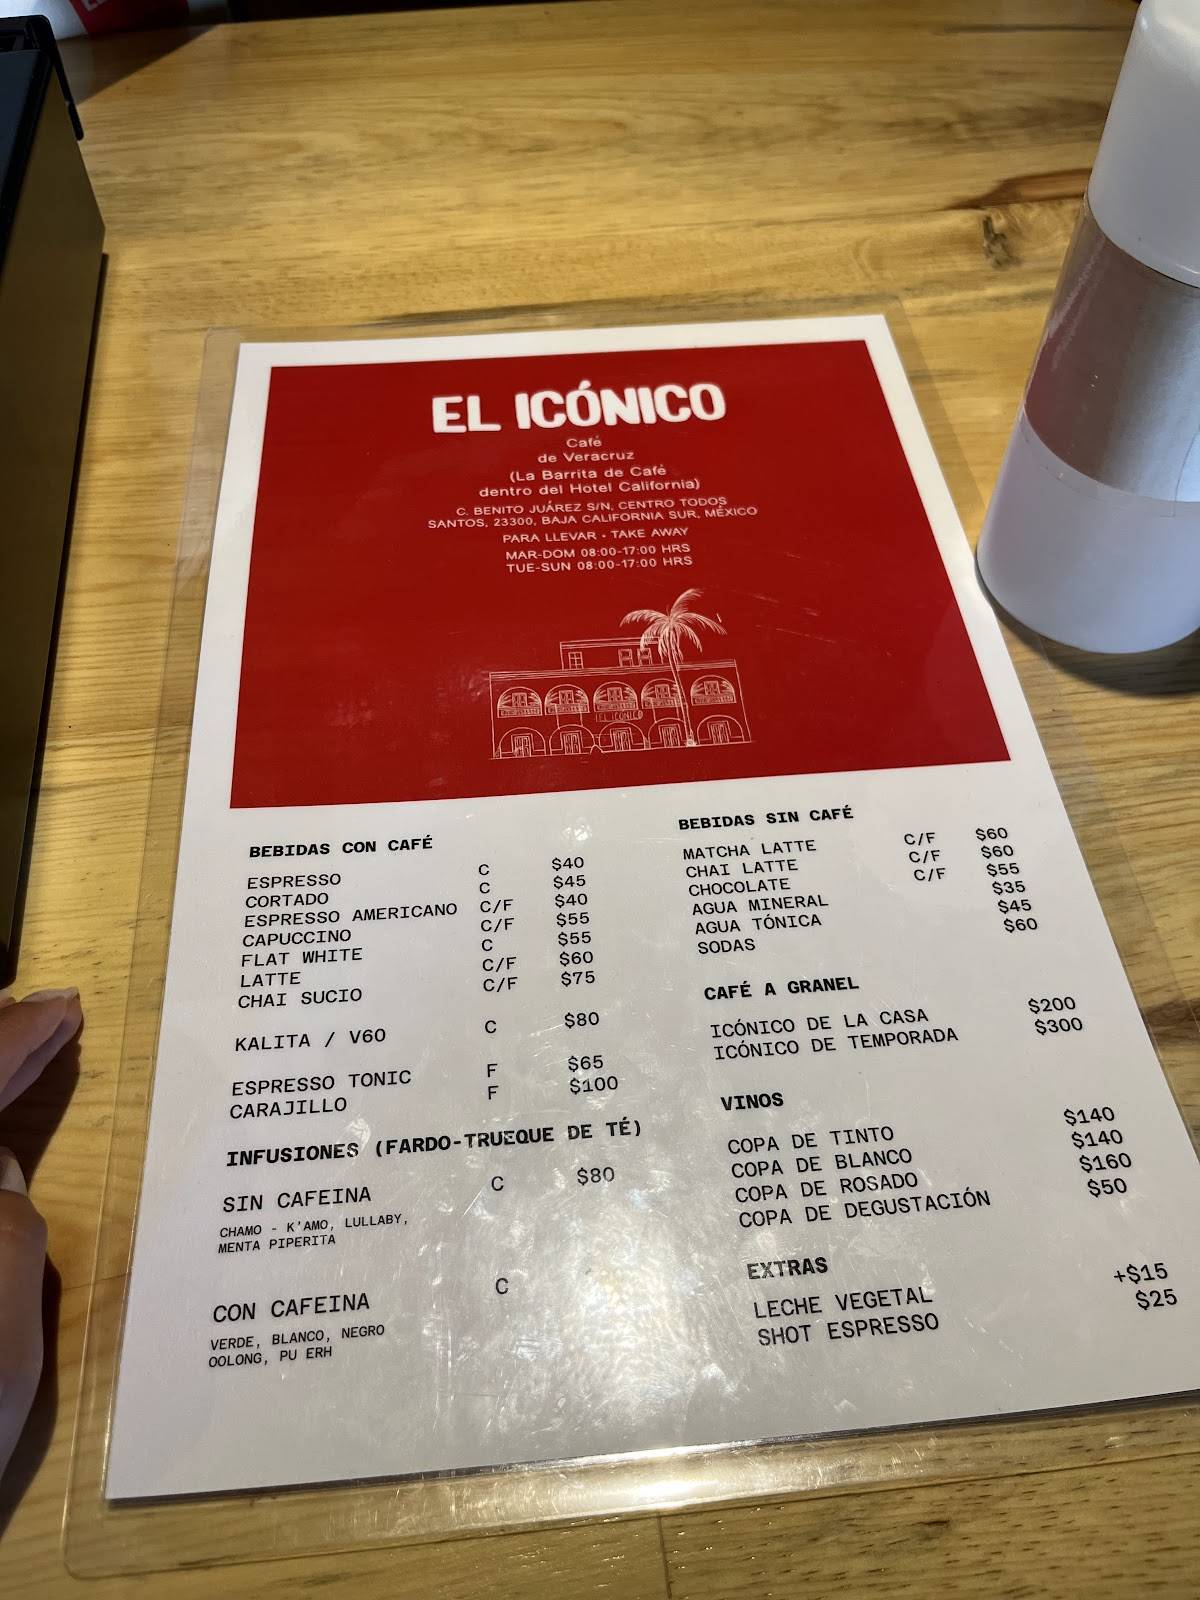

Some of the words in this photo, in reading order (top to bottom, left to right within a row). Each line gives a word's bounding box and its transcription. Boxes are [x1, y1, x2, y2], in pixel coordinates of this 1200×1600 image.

[432, 395, 502, 433] EL
[515, 379, 726, 429] ICÓNICO
[538, 454, 557, 463] de
[563, 452, 634, 462] Veracruz
[566, 436, 602, 447] Café
[479, 487, 532, 497] dentro
[539, 485, 563, 495] del
[570, 483, 612, 493] Hotel
[619, 478, 700, 492] California)
[510, 471, 535, 483] (La
[542, 470, 597, 480] Barrita
[604, 468, 623, 477] de
[630, 464, 666, 476] Café
[456, 508, 468, 516] C.
[474, 505, 524, 515] BENITO
[529, 501, 581, 513] JUÁREZ
[618, 499, 675, 509] CENTRO
[680, 496, 727, 507] TODOS
[542, 516, 577, 525] BAJA
[582, 512, 664, 523] CALIFORNIA
[704, 506, 758, 517] MÉXICO
[503, 534, 540, 543] PARA
[545, 532, 597, 541] LLEVAR
[611, 529, 645, 538] TAKE
[651, 528, 688, 537] AWAY
[506, 549, 575, 560] MAR-DOM
[581, 546, 656, 557] 08:00-17:00
[662, 544, 690, 553] HRS
[506, 562, 571, 573] TUE-SUN
[577, 558, 657, 570] 08:00-17:00
[663, 556, 692, 566] HRS
[679, 814, 755, 830] BEBIDAS
[766, 811, 799, 824] SIN
[810, 805, 854, 821] CAFÉ
[249, 843, 330, 858] BEBIDAS
[342, 841, 376, 853] CON
[388, 835, 432, 851] CAFÉ
[683, 845, 750, 860] MATCHA
[761, 840, 816, 854] LATTE
[904, 832, 935, 846] C/F
[976, 828, 1008, 842] $60
[248, 874, 341, 889] ESPRESSO
[479, 864, 489, 875] C
[552, 857, 584, 871] $40
[686, 864, 730, 878] CHAI
[742, 859, 798, 874] LATTE
[909, 850, 940, 863] C/F
[981, 845, 1013, 859] $60
[246, 893, 328, 908] CORTADO
[479, 882, 490, 894] C
[554, 875, 586, 890] $45
[689, 878, 791, 896] CHOCOLATE
[914, 868, 945, 882] C/F
[986, 863, 1019, 877] $55
[245, 911, 340, 927] ESPRESSO
[352, 903, 457, 921] AMERICANO
[480, 899, 513, 913] C/F
[555, 893, 587, 908] $40
[693, 901, 737, 915] AGUA
[748, 895, 829, 911] MINERAL
[992, 881, 1025, 895] $35
[243, 929, 351, 947] CAPUCCINO
[481, 918, 514, 932] C/F
[557, 912, 589, 927] $55
[696, 920, 741, 935] AGUA
[752, 914, 822, 930] TÓNICA
[998, 899, 1031, 914] $45
[242, 952, 290, 967] FLAT
[303, 948, 362, 963] WHITE
[482, 939, 493, 951] C
[558, 931, 591, 947] $55
[698, 938, 755, 954] SODAS
[1004, 918, 1038, 933] $60
[241, 972, 301, 987] LATTE
[483, 957, 516, 972] C/F
[560, 951, 593, 967] $60
[238, 993, 287, 1008] CHAI
[301, 988, 362, 1004] SUCIO
[483, 977, 518, 992] C/F
[561, 971, 595, 987] $75
[704, 981, 752, 1000] CAFÉ
[765, 983, 776, 996] A
[787, 977, 859, 994] GRANEL
[235, 1034, 310, 1051] KALITA
[325, 1032, 335, 1047] /
[349, 1029, 386, 1044] V60
[485, 1020, 496, 1033] C
[565, 1012, 599, 1029] $80
[710, 1019, 795, 1038] ICÓNICO
[807, 1016, 832, 1030] DE
[844, 1013, 868, 1028] LA
[880, 1009, 929, 1025] CASA
[1028, 997, 1075, 1014] $200
[714, 1040, 799, 1060] ICÓNICO
[811, 1037, 836, 1052] DE
[847, 1028, 958, 1049] TEMPORADA
[1035, 1018, 1083, 1036] $300
[232, 1076, 334, 1096] ESPRESSO
[348, 1070, 411, 1088] TONIC
[487, 1063, 498, 1077] F
[568, 1055, 603, 1072] $65
[230, 1097, 347, 1119] CARAJILLO
[488, 1085, 499, 1100] F
[570, 1076, 618, 1095] $100
[720, 1092, 784, 1110] VINOS
[227, 1143, 358, 1166] INFUSIONES
[376, 1127, 554, 1157] (FARDO-TRUEQUE
[568, 1124, 592, 1140] DE
[606, 1117, 640, 1136] TÉ)
[728, 1136, 780, 1154] COPA
[792, 1133, 818, 1149] DE
[829, 1126, 894, 1145] TINTO
[1064, 1107, 1114, 1126] $140
[732, 1160, 783, 1178] COPA
[796, 1156, 822, 1173] DE
[835, 1148, 912, 1169] BLANCO
[1071, 1130, 1123, 1149] $140
[223, 1195, 263, 1212] SIN
[278, 1187, 371, 1208] CAFEINA
[491, 1176, 504, 1191] C
[577, 1167, 614, 1186] $80
[735, 1184, 788, 1203] COPA
[801, 1180, 827, 1197] DE
[840, 1172, 918, 1194] ROSADO
[1079, 1153, 1131, 1173] $160
[739, 1209, 792, 1228] COPA
[805, 1205, 832, 1222] DE
[844, 1187, 990, 1218] DEGUSTACIÓN
[1087, 1178, 1127, 1198] $50
[220, 1225, 261, 1238] CHAMO
[287, 1220, 333, 1232] K'AMO,
[345, 1214, 407, 1227] LULLABY,
[218, 1240, 260, 1253] MENTA
[269, 1234, 336, 1249] PIPERITA
[747, 1257, 828, 1279] EXTRAS
[213, 1302, 256, 1323] CON
[271, 1293, 369, 1317] CAFEINA
[496, 1278, 508, 1295] C
[754, 1296, 822, 1318] LECHE
[835, 1287, 933, 1310] VEGETAL
[1114, 1263, 1168, 1284] +$15
[758, 1324, 811, 1346] SHOT
[827, 1313, 939, 1339] ESPRESSO
[1136, 1289, 1177, 1311] $25
[211, 1336, 259, 1350] VERDE,
[272, 1330, 329, 1345] BLANCO,
[342, 1325, 384, 1339] NEGRO
[209, 1352, 267, 1368] OOLONG,
[280, 1349, 297, 1361] PU
[306, 1346, 332, 1359] ERH
